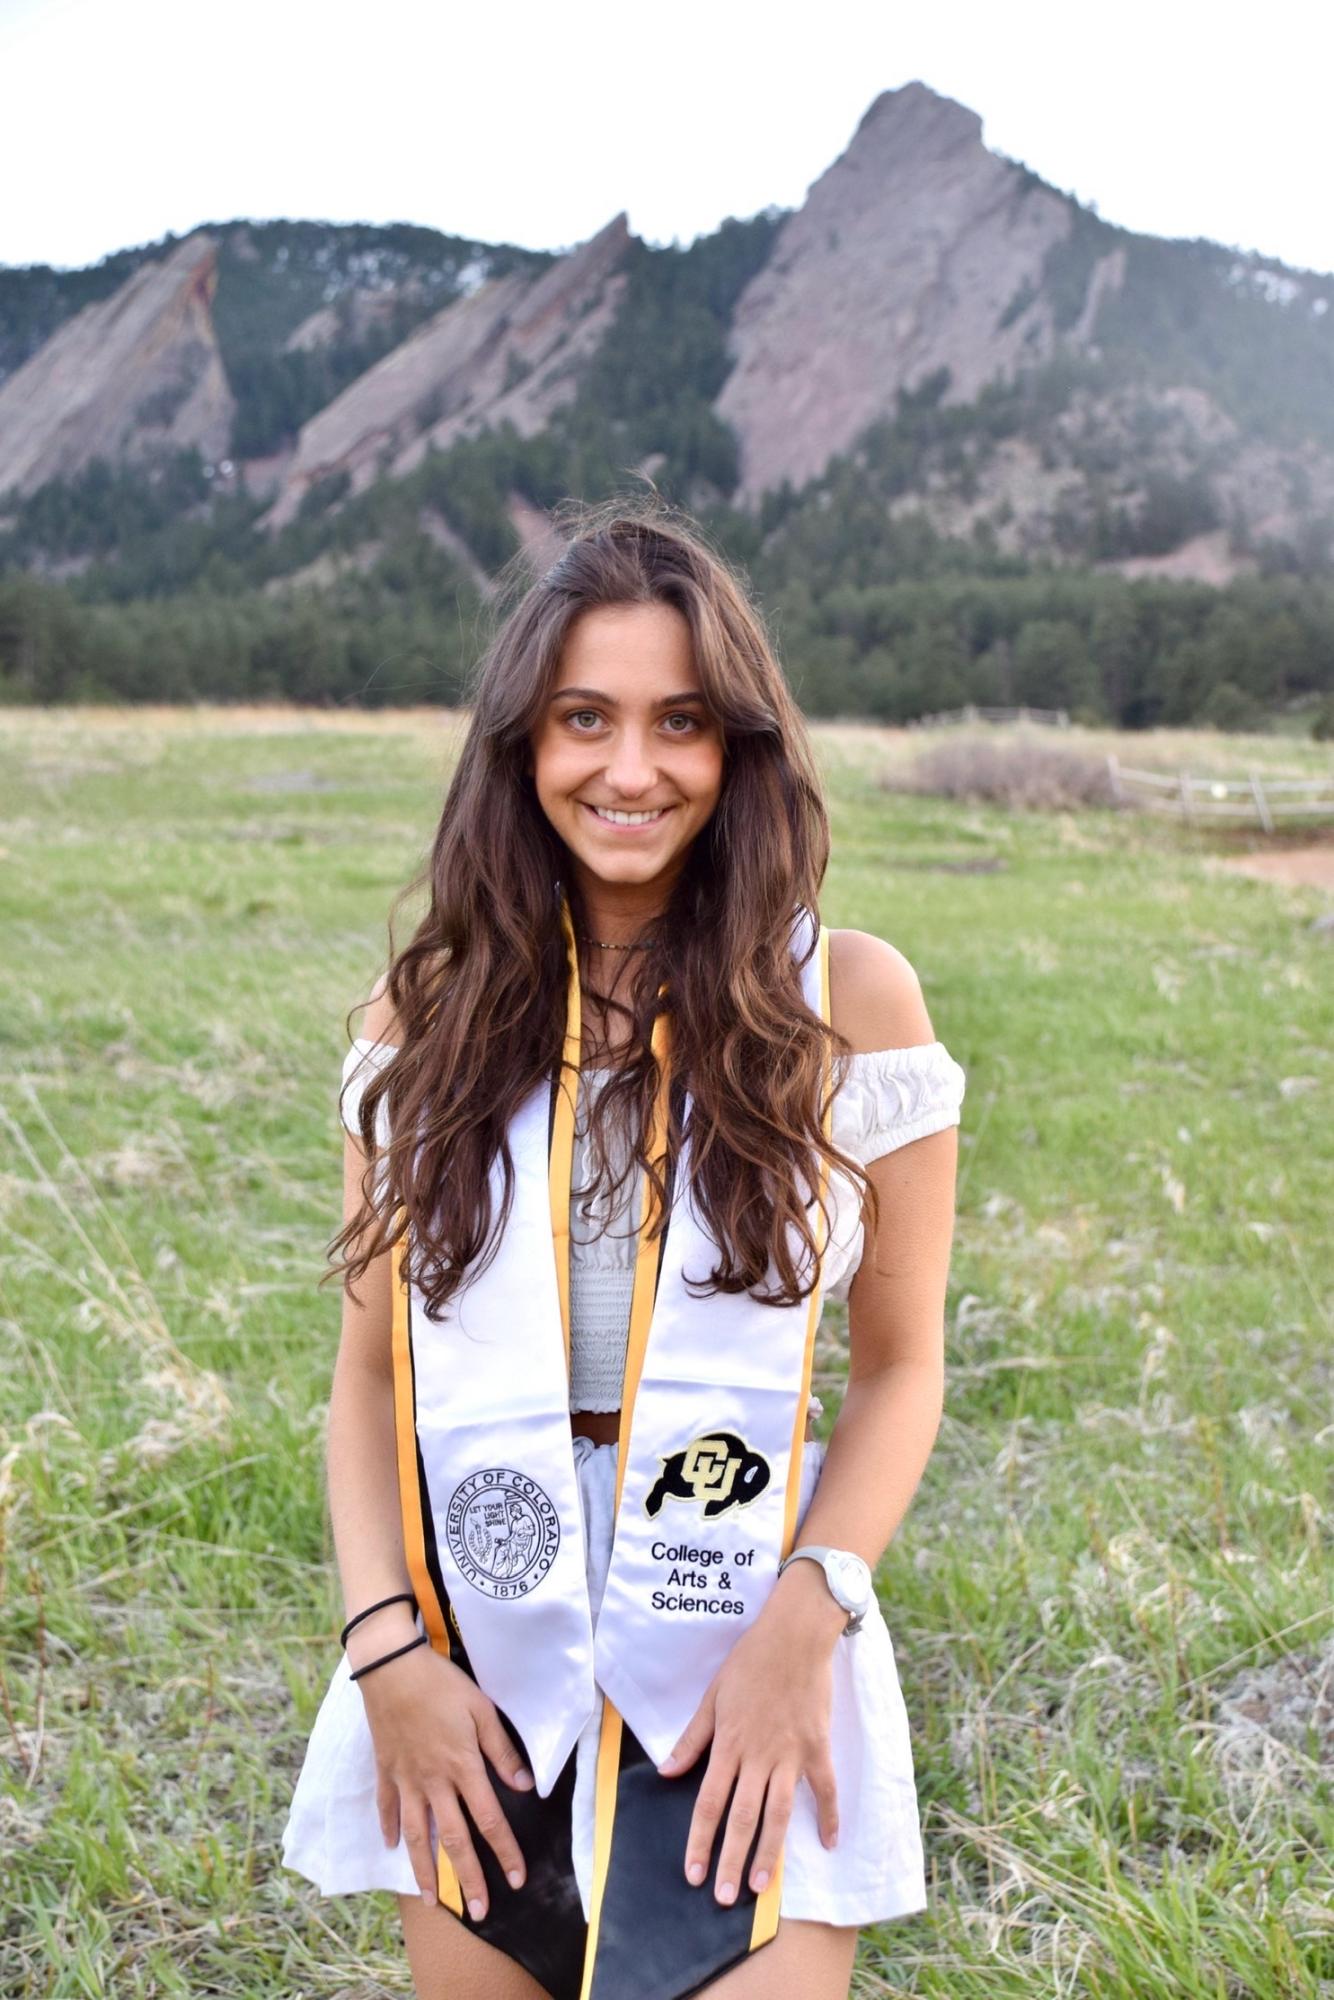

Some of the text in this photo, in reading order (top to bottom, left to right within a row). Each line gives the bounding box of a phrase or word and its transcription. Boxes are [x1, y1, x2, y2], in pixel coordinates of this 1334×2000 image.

[680, 1440, 742, 1501] CU
[470, 1502, 503, 1514] LET YOUR
[484, 1510, 504, 1520] LIGHT
[449, 1472, 557, 1581] UNIVERSITY OF COLORADO
[485, 1518, 506, 1528] SHINE
[651, 1542, 755, 1567] College of
[493, 1580, 528, 1597] 1876
[667, 1568, 732, 1590] Arts &
[651, 1591, 744, 1615] Sciences
